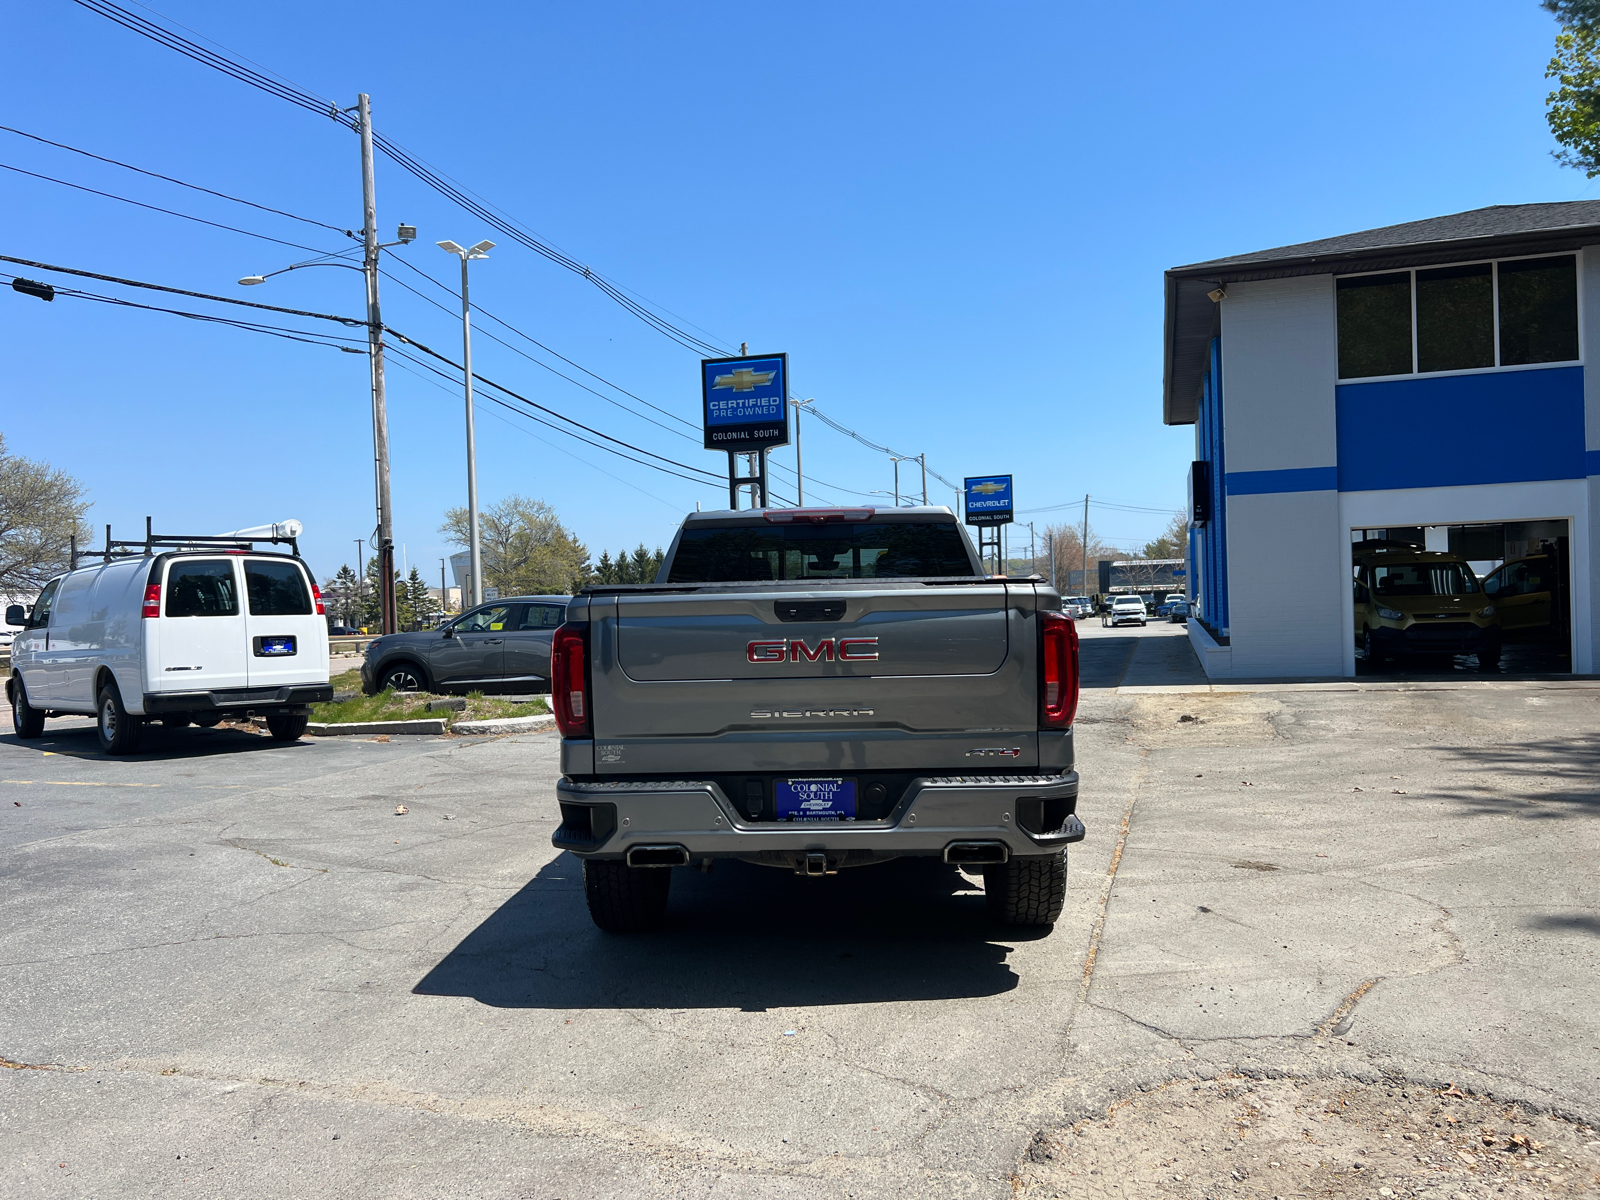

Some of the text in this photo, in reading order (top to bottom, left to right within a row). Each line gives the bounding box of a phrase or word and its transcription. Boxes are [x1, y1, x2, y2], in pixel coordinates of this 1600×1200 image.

[710, 397, 779, 409] CERTIFIED
[713, 406, 776, 417] PRE-OWNED
[712, 429, 779, 440] COLONIAL SOUTH
[969, 500, 1009, 508] CHEVROLET
[746, 636, 880, 664] GMC
[750, 707, 875, 719] SIERRA
[965, 747, 1021, 759] AT4
[791, 784, 840, 792] COLONIAL
[799, 791, 833, 800] SOUTH
